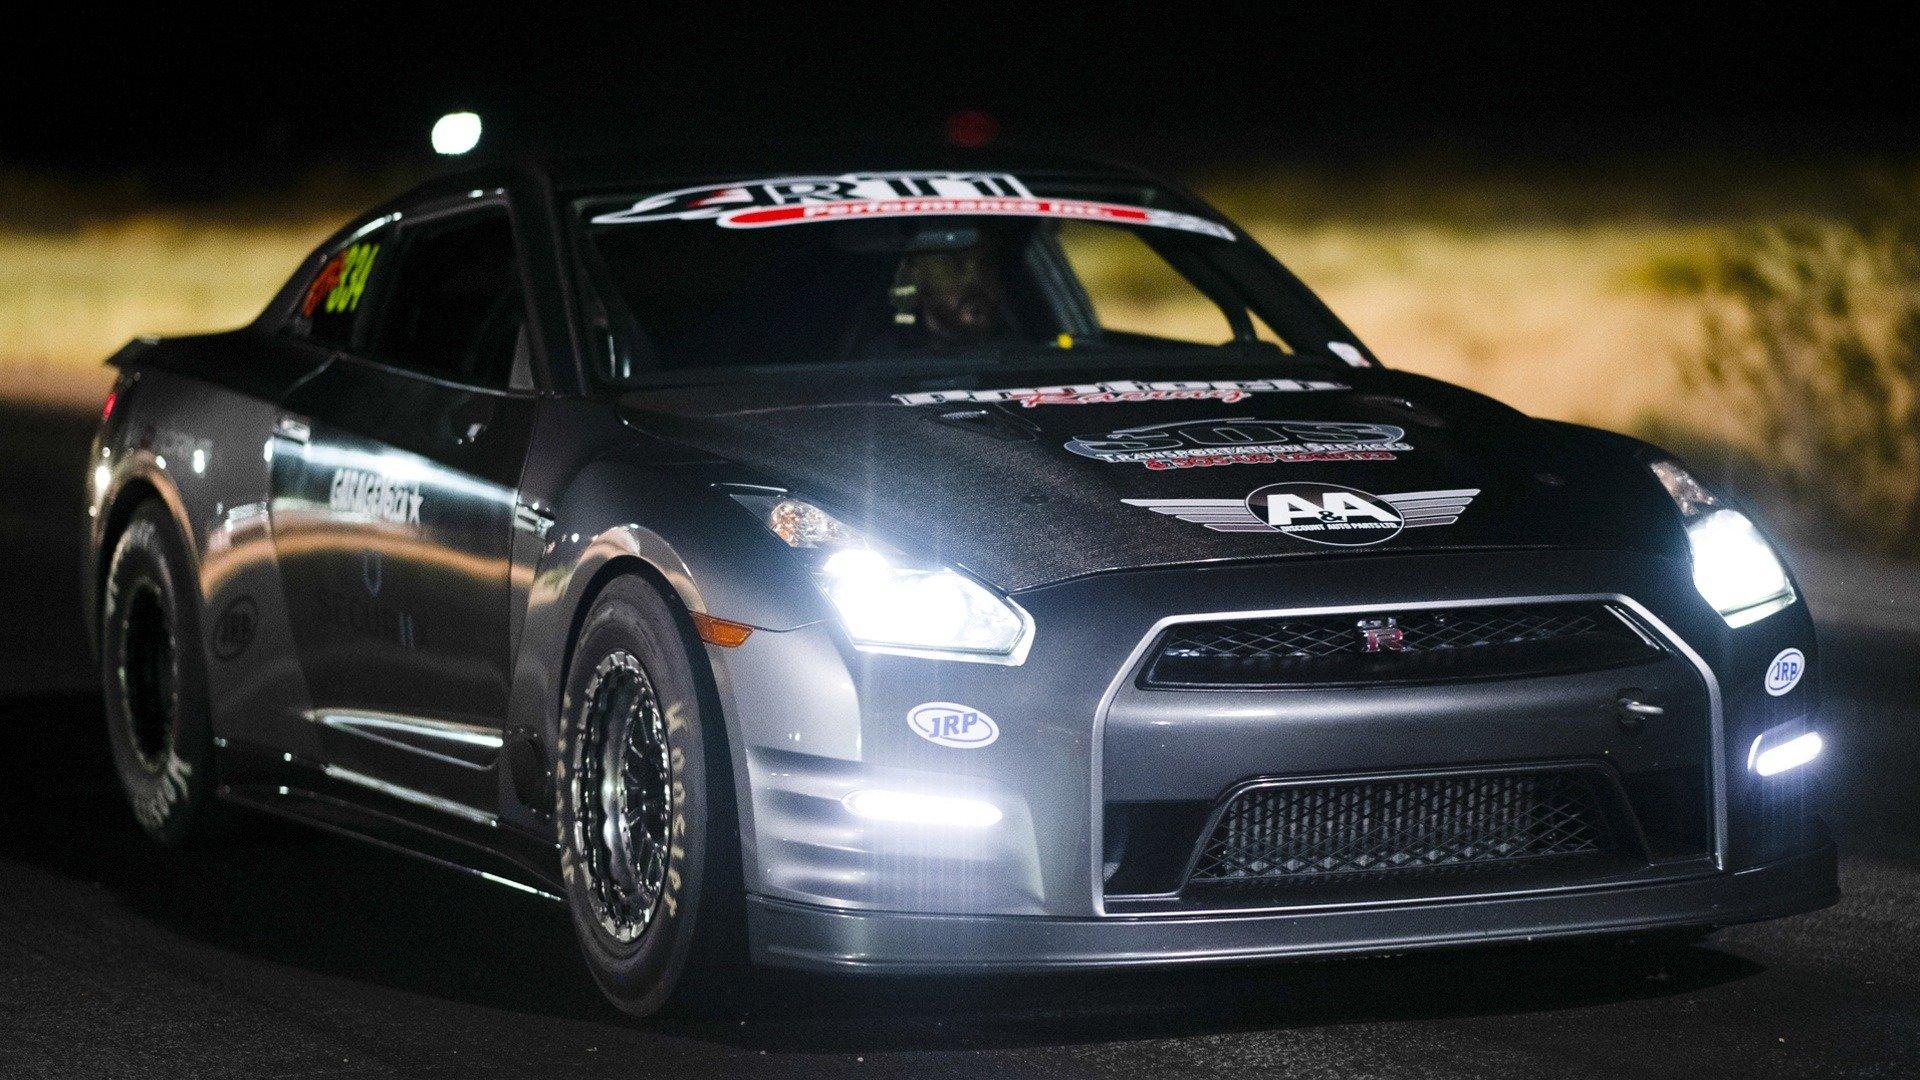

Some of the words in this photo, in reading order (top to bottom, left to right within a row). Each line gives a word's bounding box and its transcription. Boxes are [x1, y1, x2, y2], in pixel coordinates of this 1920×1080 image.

[1066, 418, 1404, 452] SOS
[1267, 492, 1402, 526] A&A
[1280, 523, 1326, 532] DISCOUNT
[1327, 522, 1350, 531] AUTO
[1774, 661, 1798, 682] JRP
[929, 712, 978, 739] JRP
